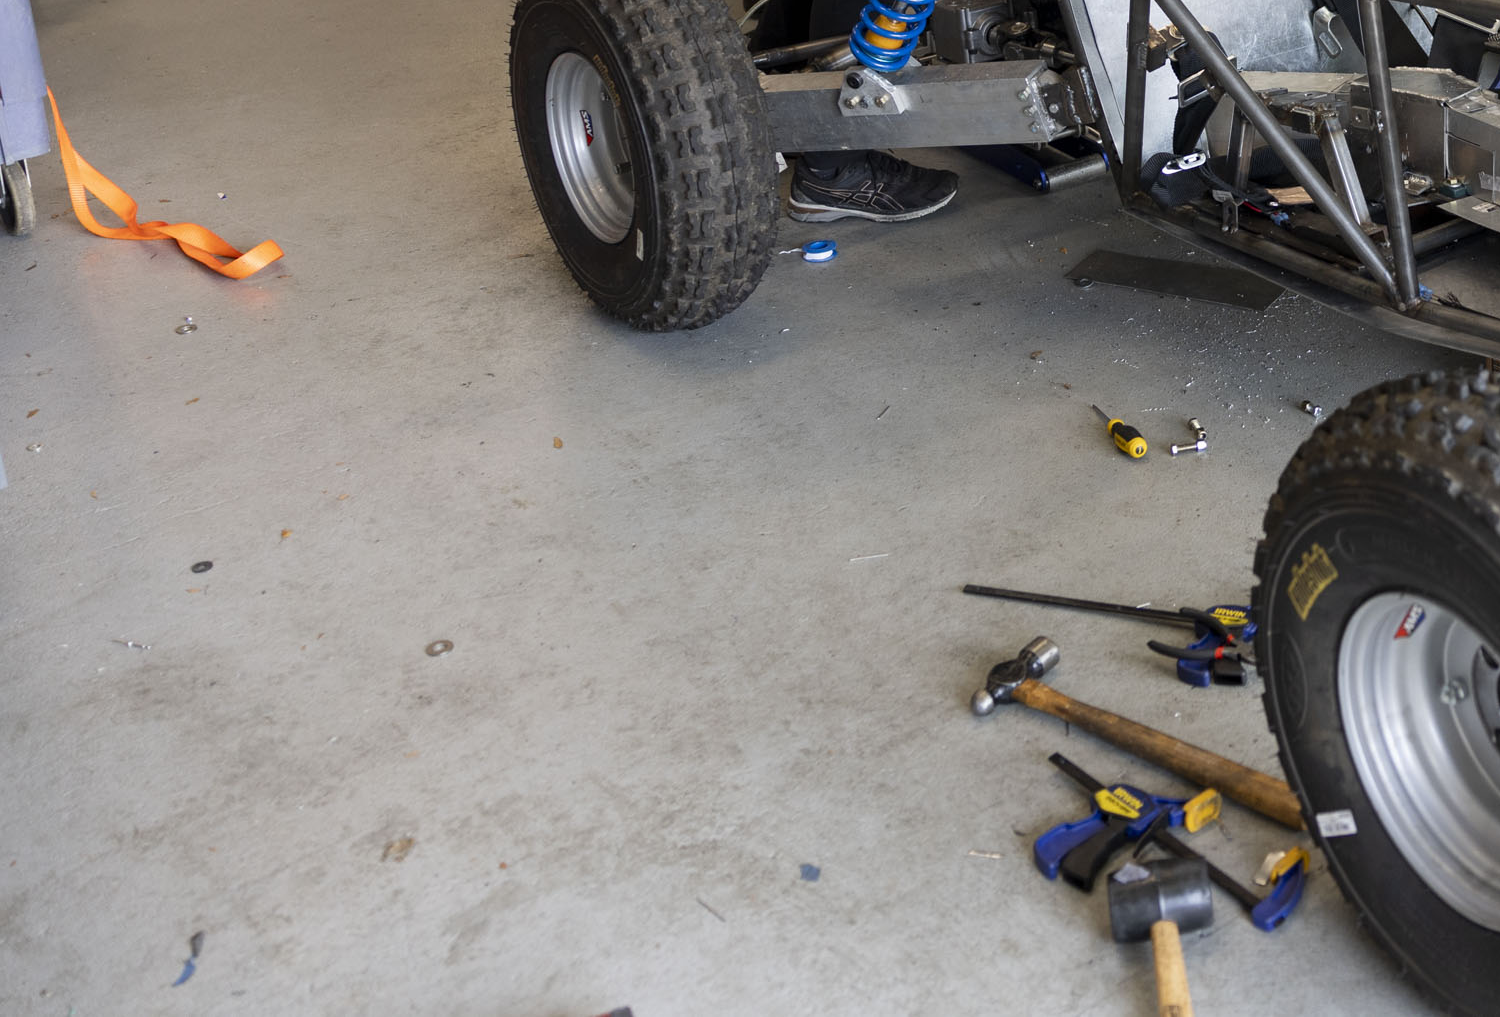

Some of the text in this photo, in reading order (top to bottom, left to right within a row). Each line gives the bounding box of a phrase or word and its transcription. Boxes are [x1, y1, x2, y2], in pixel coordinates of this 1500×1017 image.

[581, 110, 593, 137] AMS
[1214, 607, 1246, 618] IRWIN
[1113, 787, 1144, 809] IRWIN
